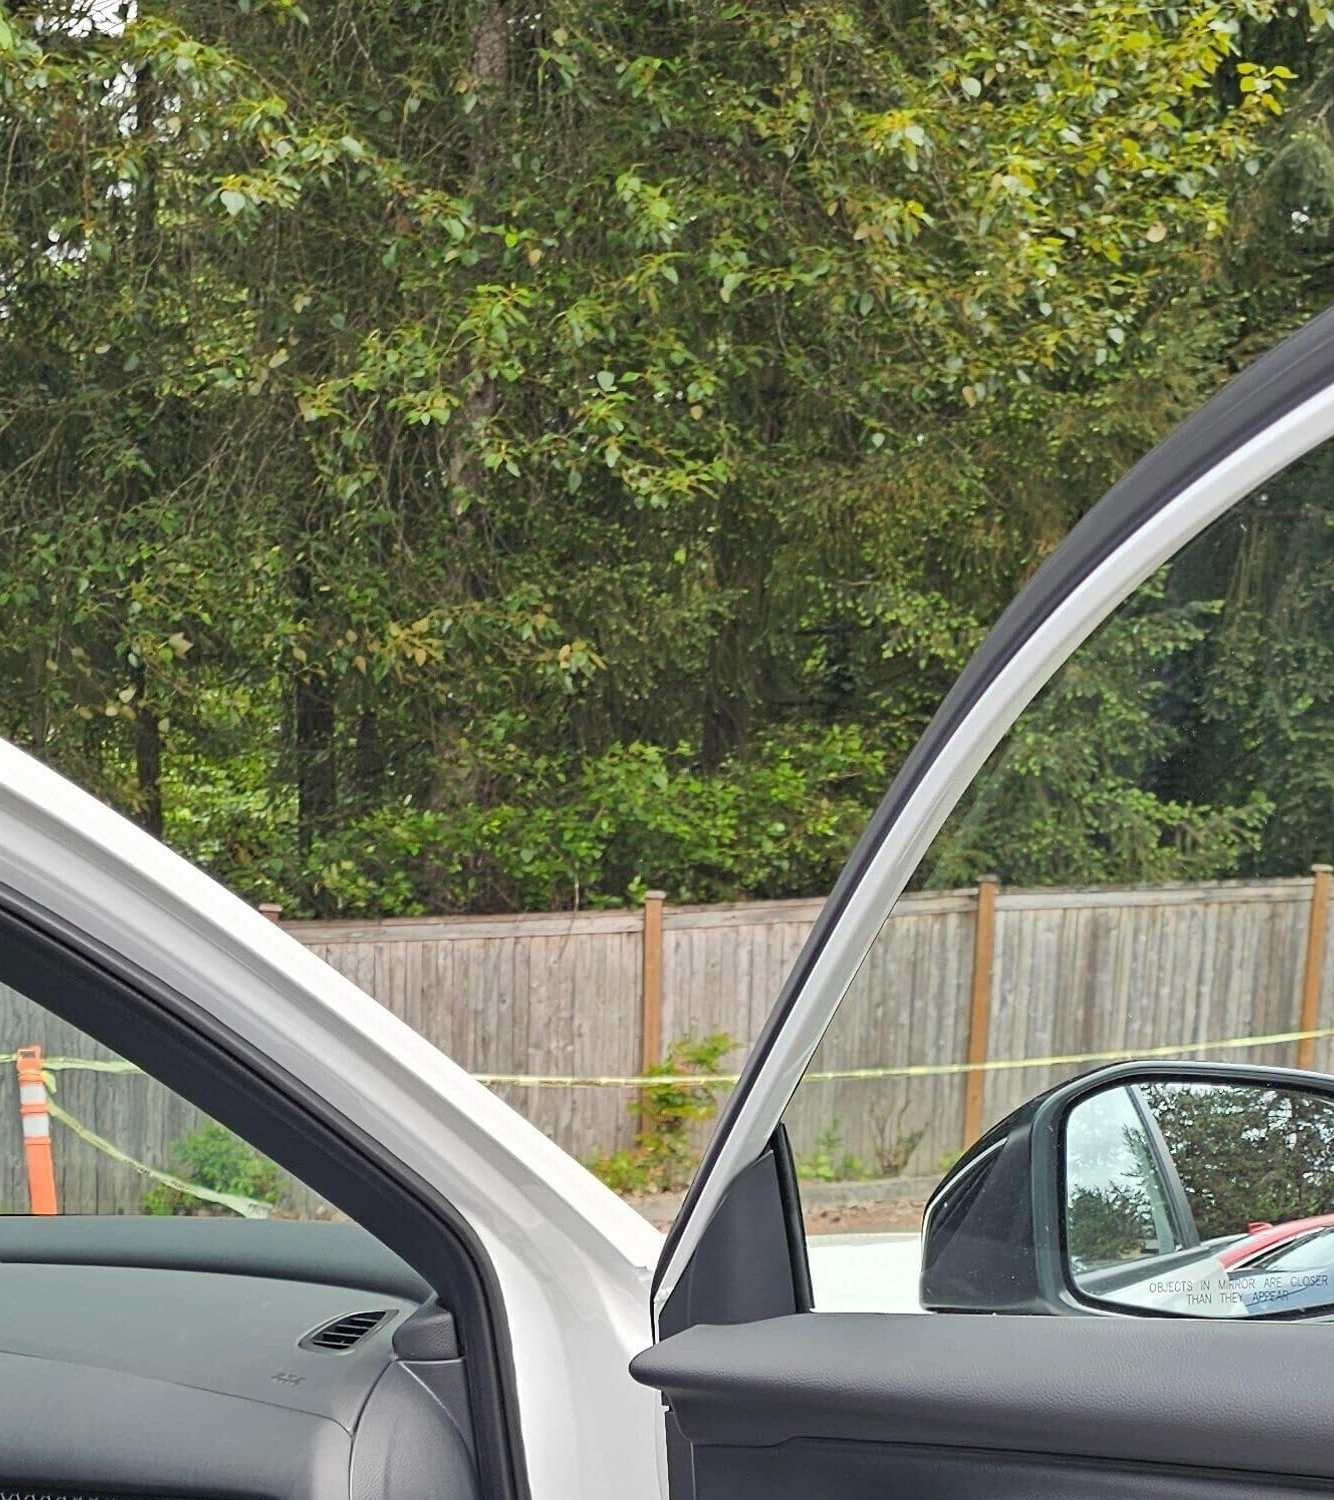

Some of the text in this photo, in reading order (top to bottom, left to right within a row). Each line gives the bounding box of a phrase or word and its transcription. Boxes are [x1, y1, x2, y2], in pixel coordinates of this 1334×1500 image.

[1149, 1274, 1329, 1293] OBJECTS IN MIRROR ARE CLOSER
[1187, 1290, 1289, 1305] THAN THEY APPEAR
